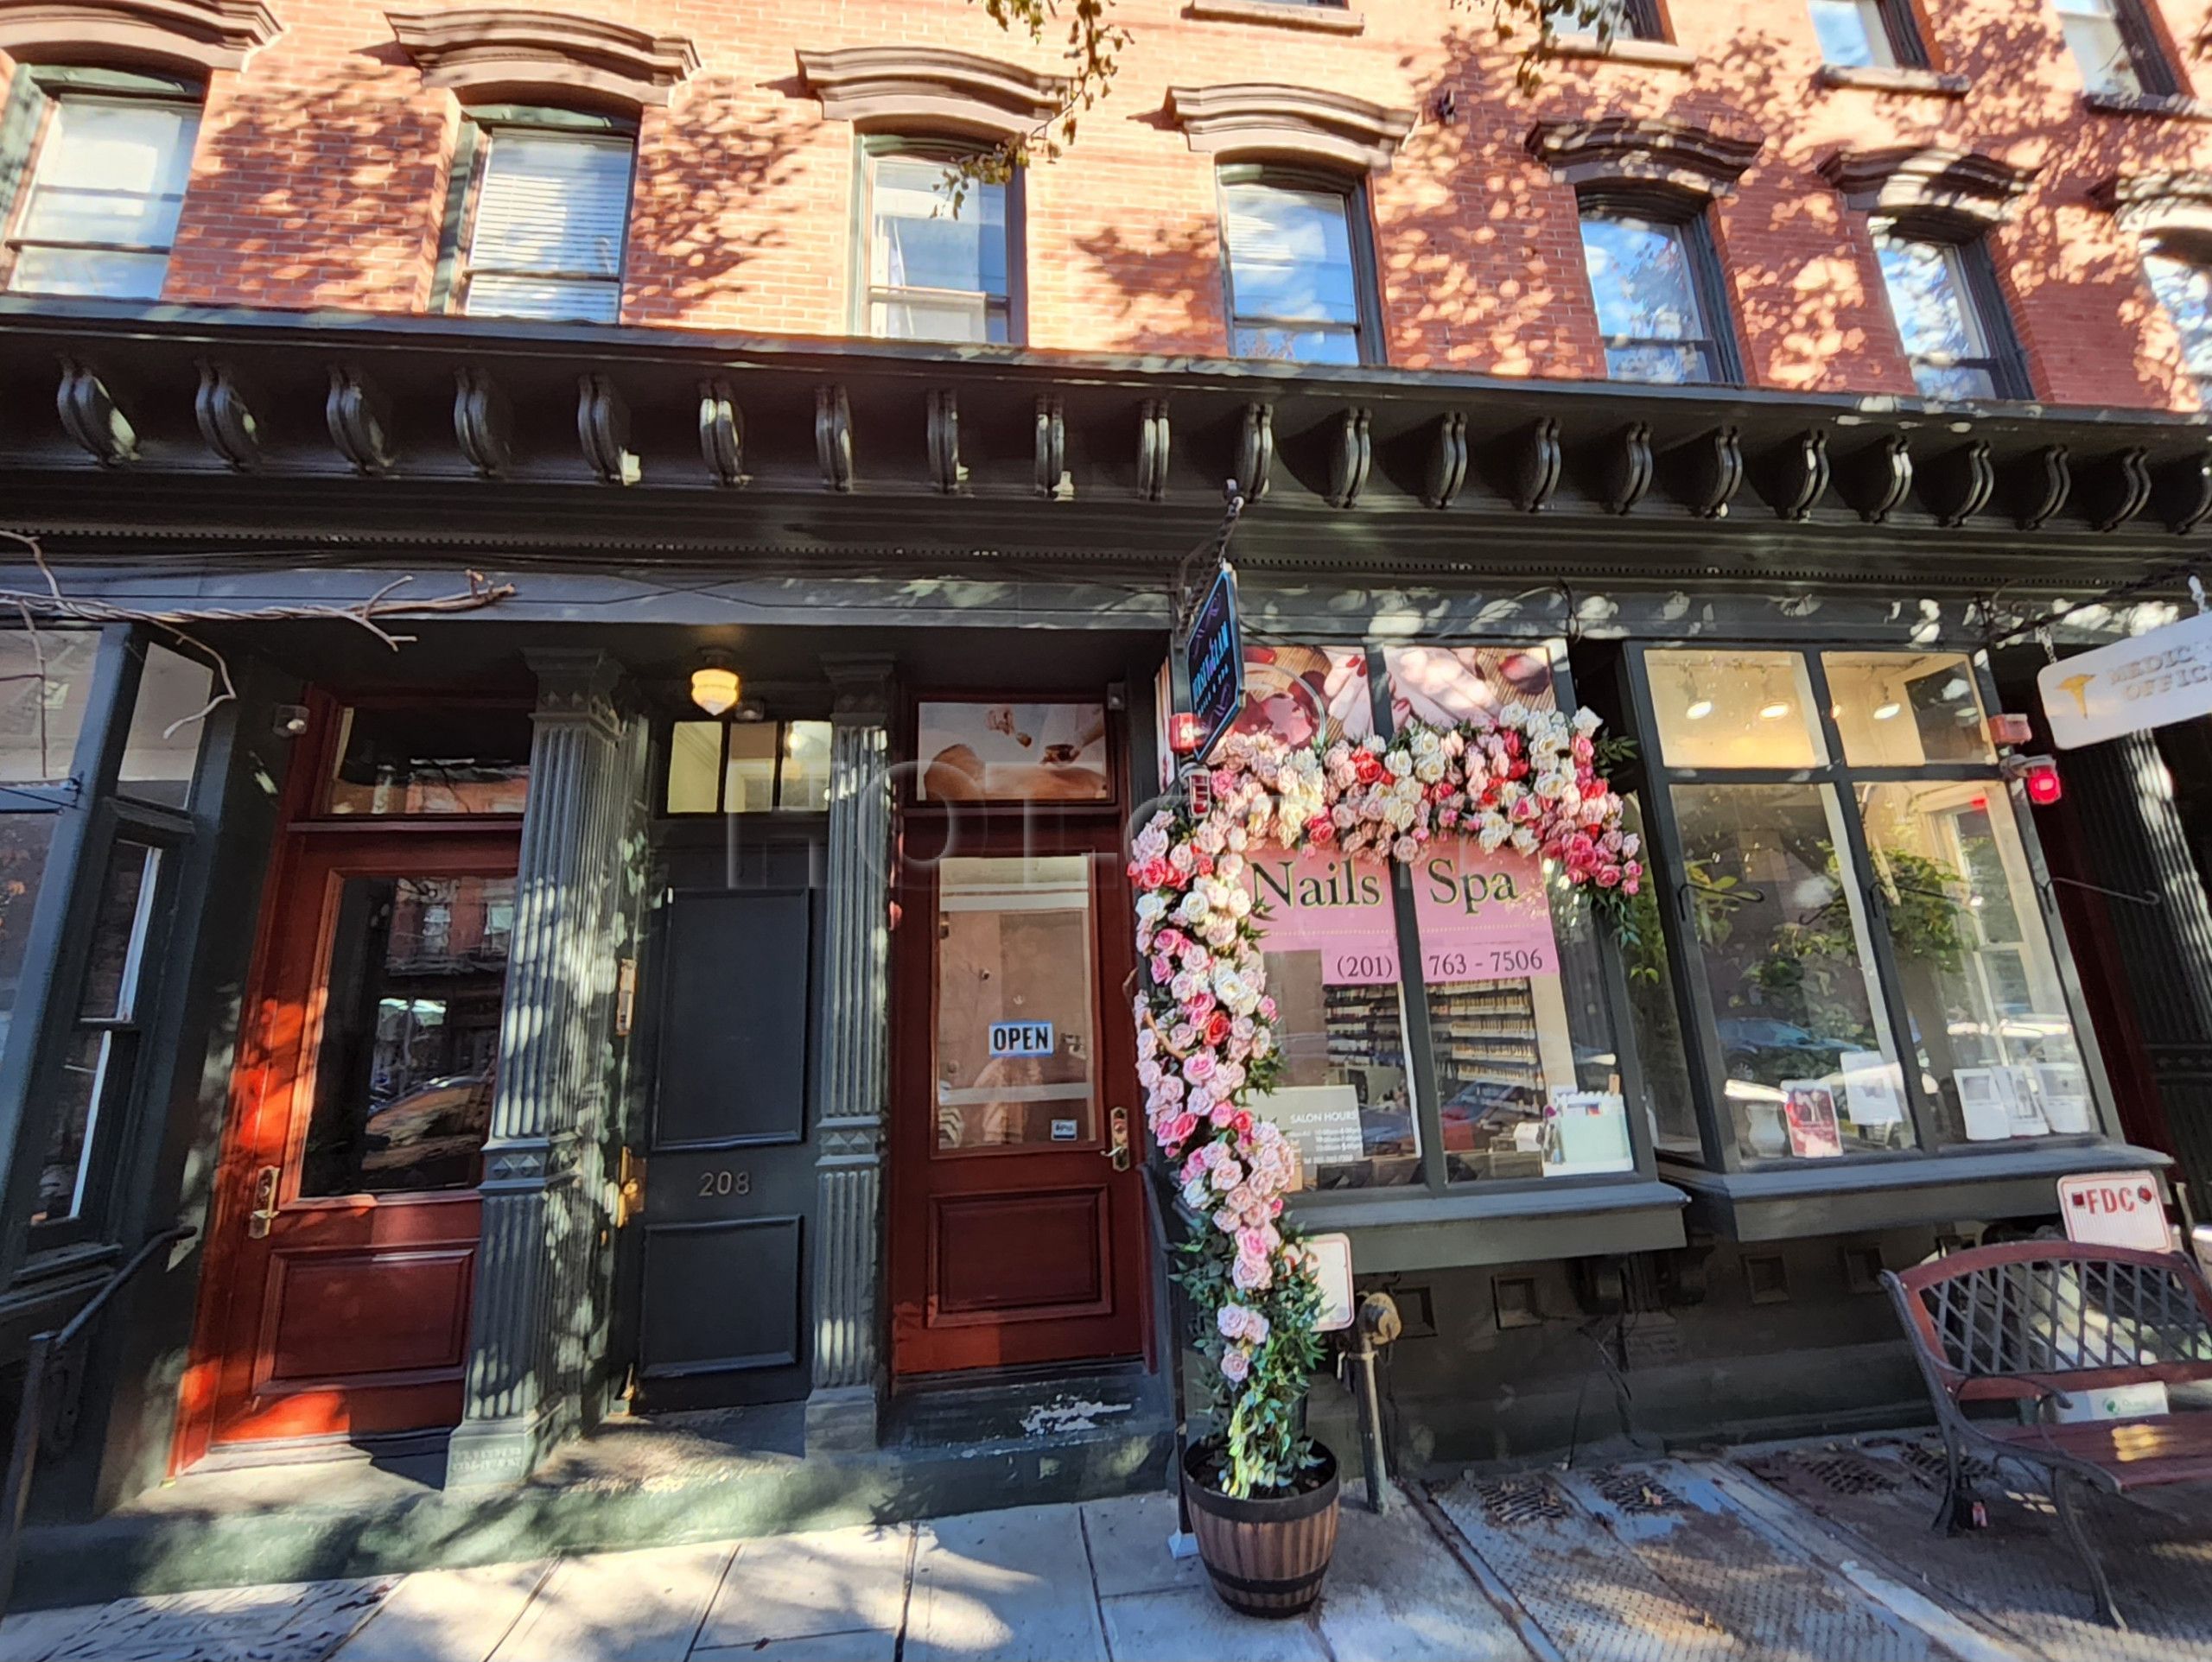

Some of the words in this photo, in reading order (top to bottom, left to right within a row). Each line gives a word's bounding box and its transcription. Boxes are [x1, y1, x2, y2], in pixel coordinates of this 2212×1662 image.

[2109, 640, 2212, 685] MEDIC
[2123, 661, 2212, 701] OFFIC
[1250, 858, 1384, 909] Nails
[1427, 858, 1520, 915] Spa
[1337, 955, 1393, 979] (201)
[1428, 953, 1467, 976] 763
[1490, 948, 1543, 972] 7506
[994, 1026, 1048, 1050] OPEN
[1290, 1112, 1322, 1124] SALON
[1324, 1109, 1359, 1121] HOURS
[698, 1171, 749, 1197] 208
[2086, 1187, 2137, 1215] FDC
